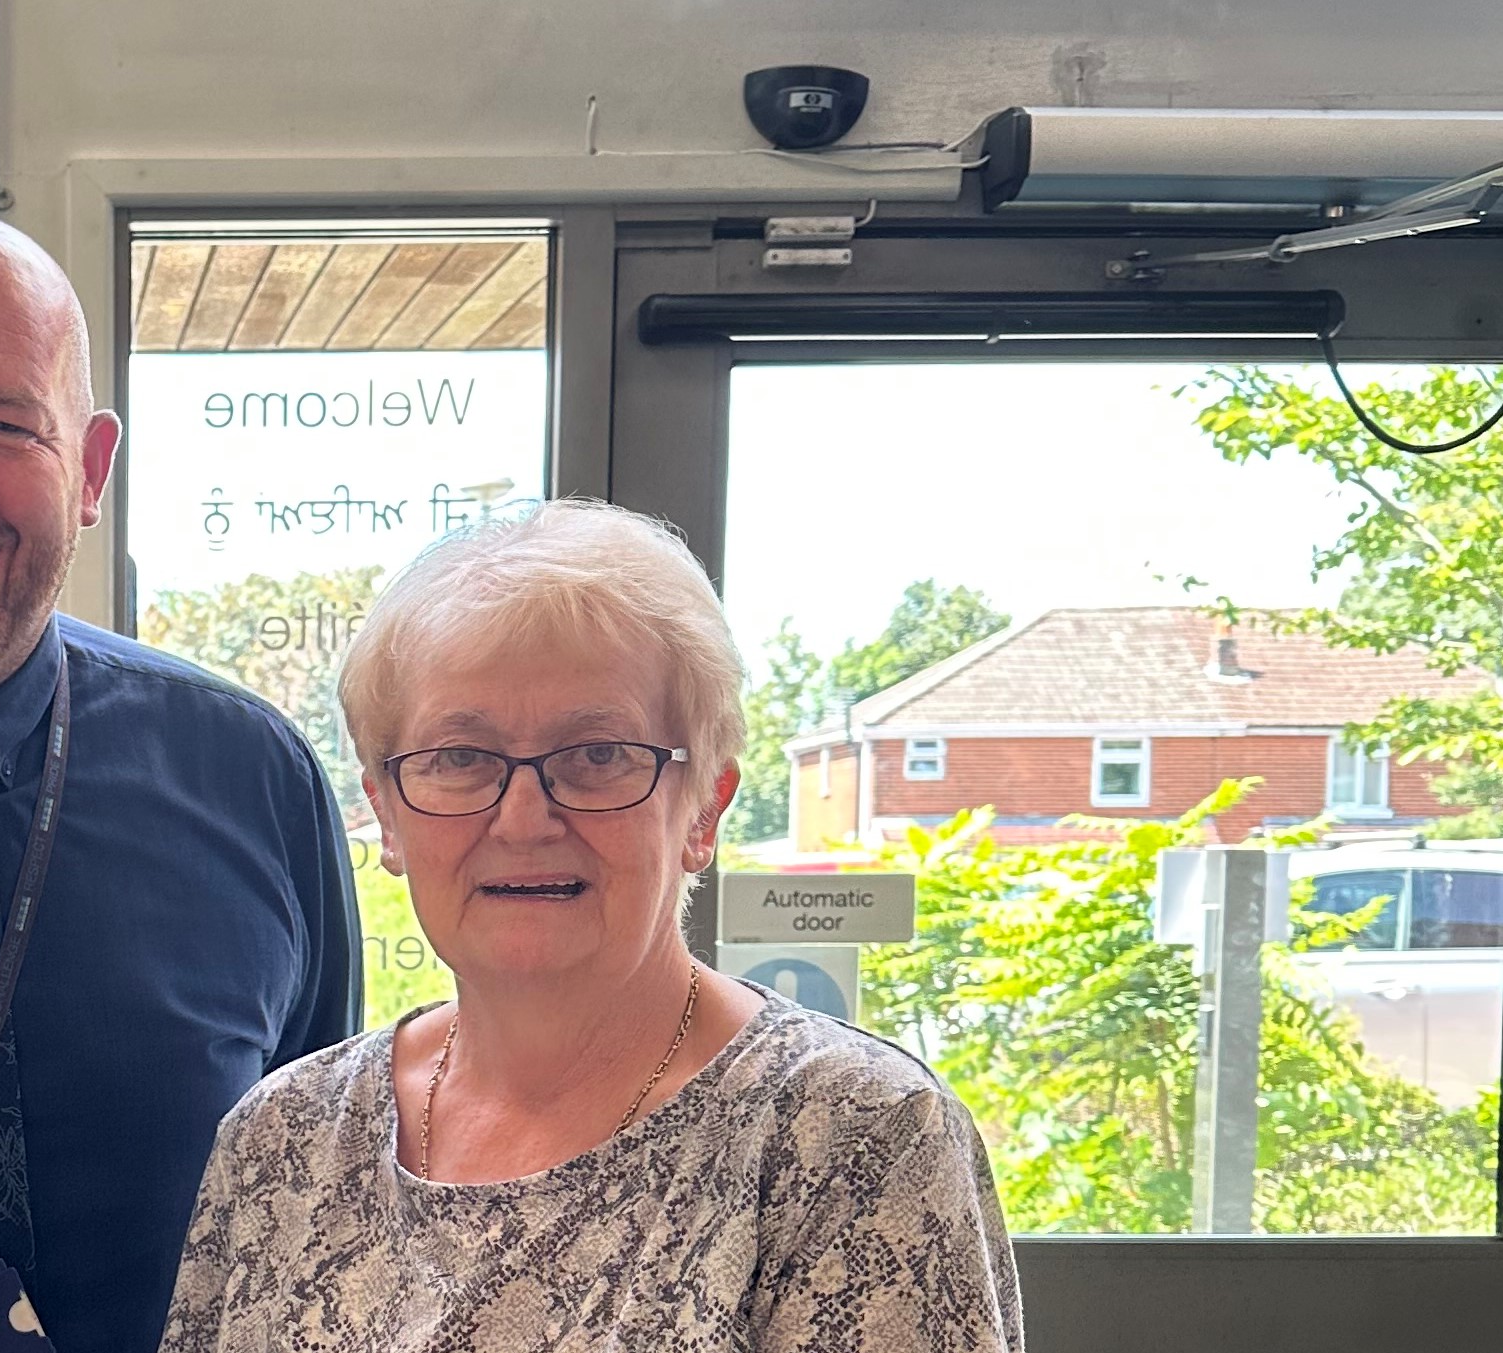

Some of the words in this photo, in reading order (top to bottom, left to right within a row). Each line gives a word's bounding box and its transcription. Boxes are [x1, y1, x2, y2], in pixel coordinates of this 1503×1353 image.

[23, 836, 46, 893] RESPECT
[46, 759, 62, 794] PRIDE
[762, 889, 875, 908] Automatic
[792, 912, 845, 932] door
